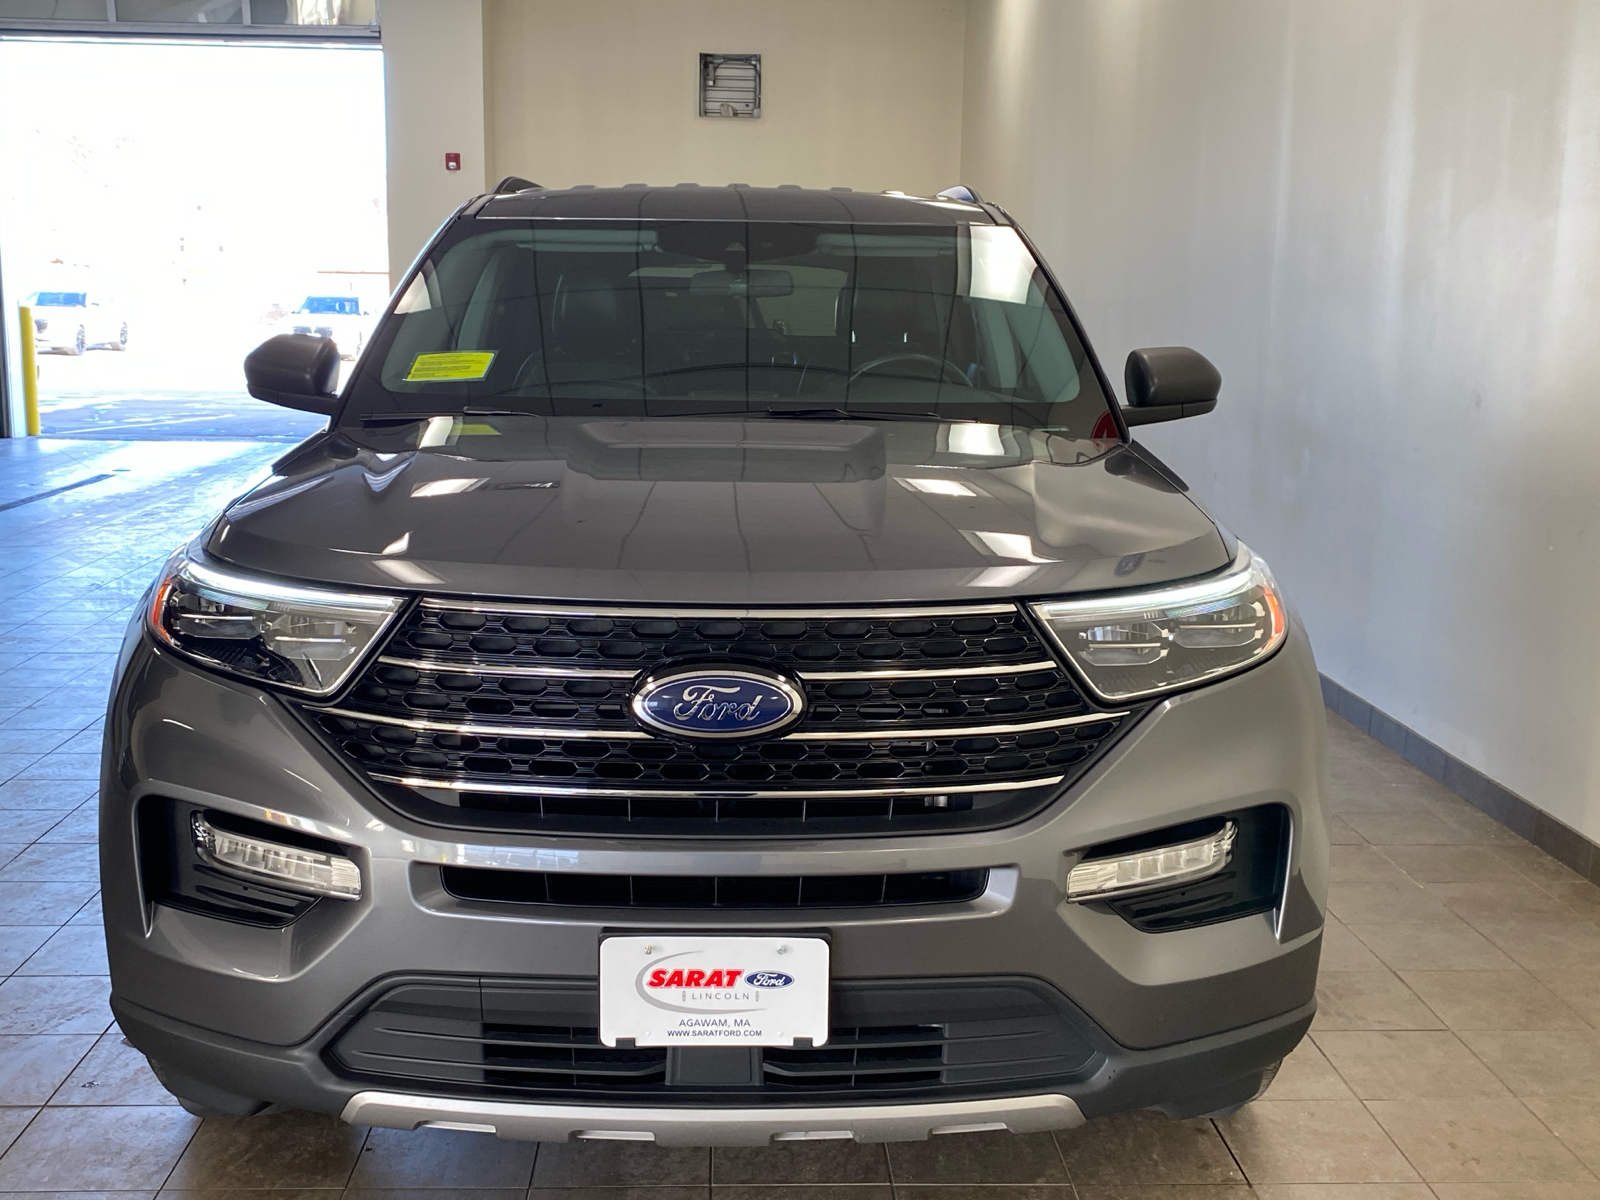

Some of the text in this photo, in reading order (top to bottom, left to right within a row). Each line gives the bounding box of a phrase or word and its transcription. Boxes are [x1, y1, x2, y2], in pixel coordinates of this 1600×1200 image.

[673, 684, 763, 721] Ford
[646, 968, 786, 989] SARAT Ford
[691, 992, 750, 1000] LINCOLN
[678, 1018, 751, 1028] AGAWAM, MA
[667, 1029, 763, 1037] WWW.SARATFORD.COM
